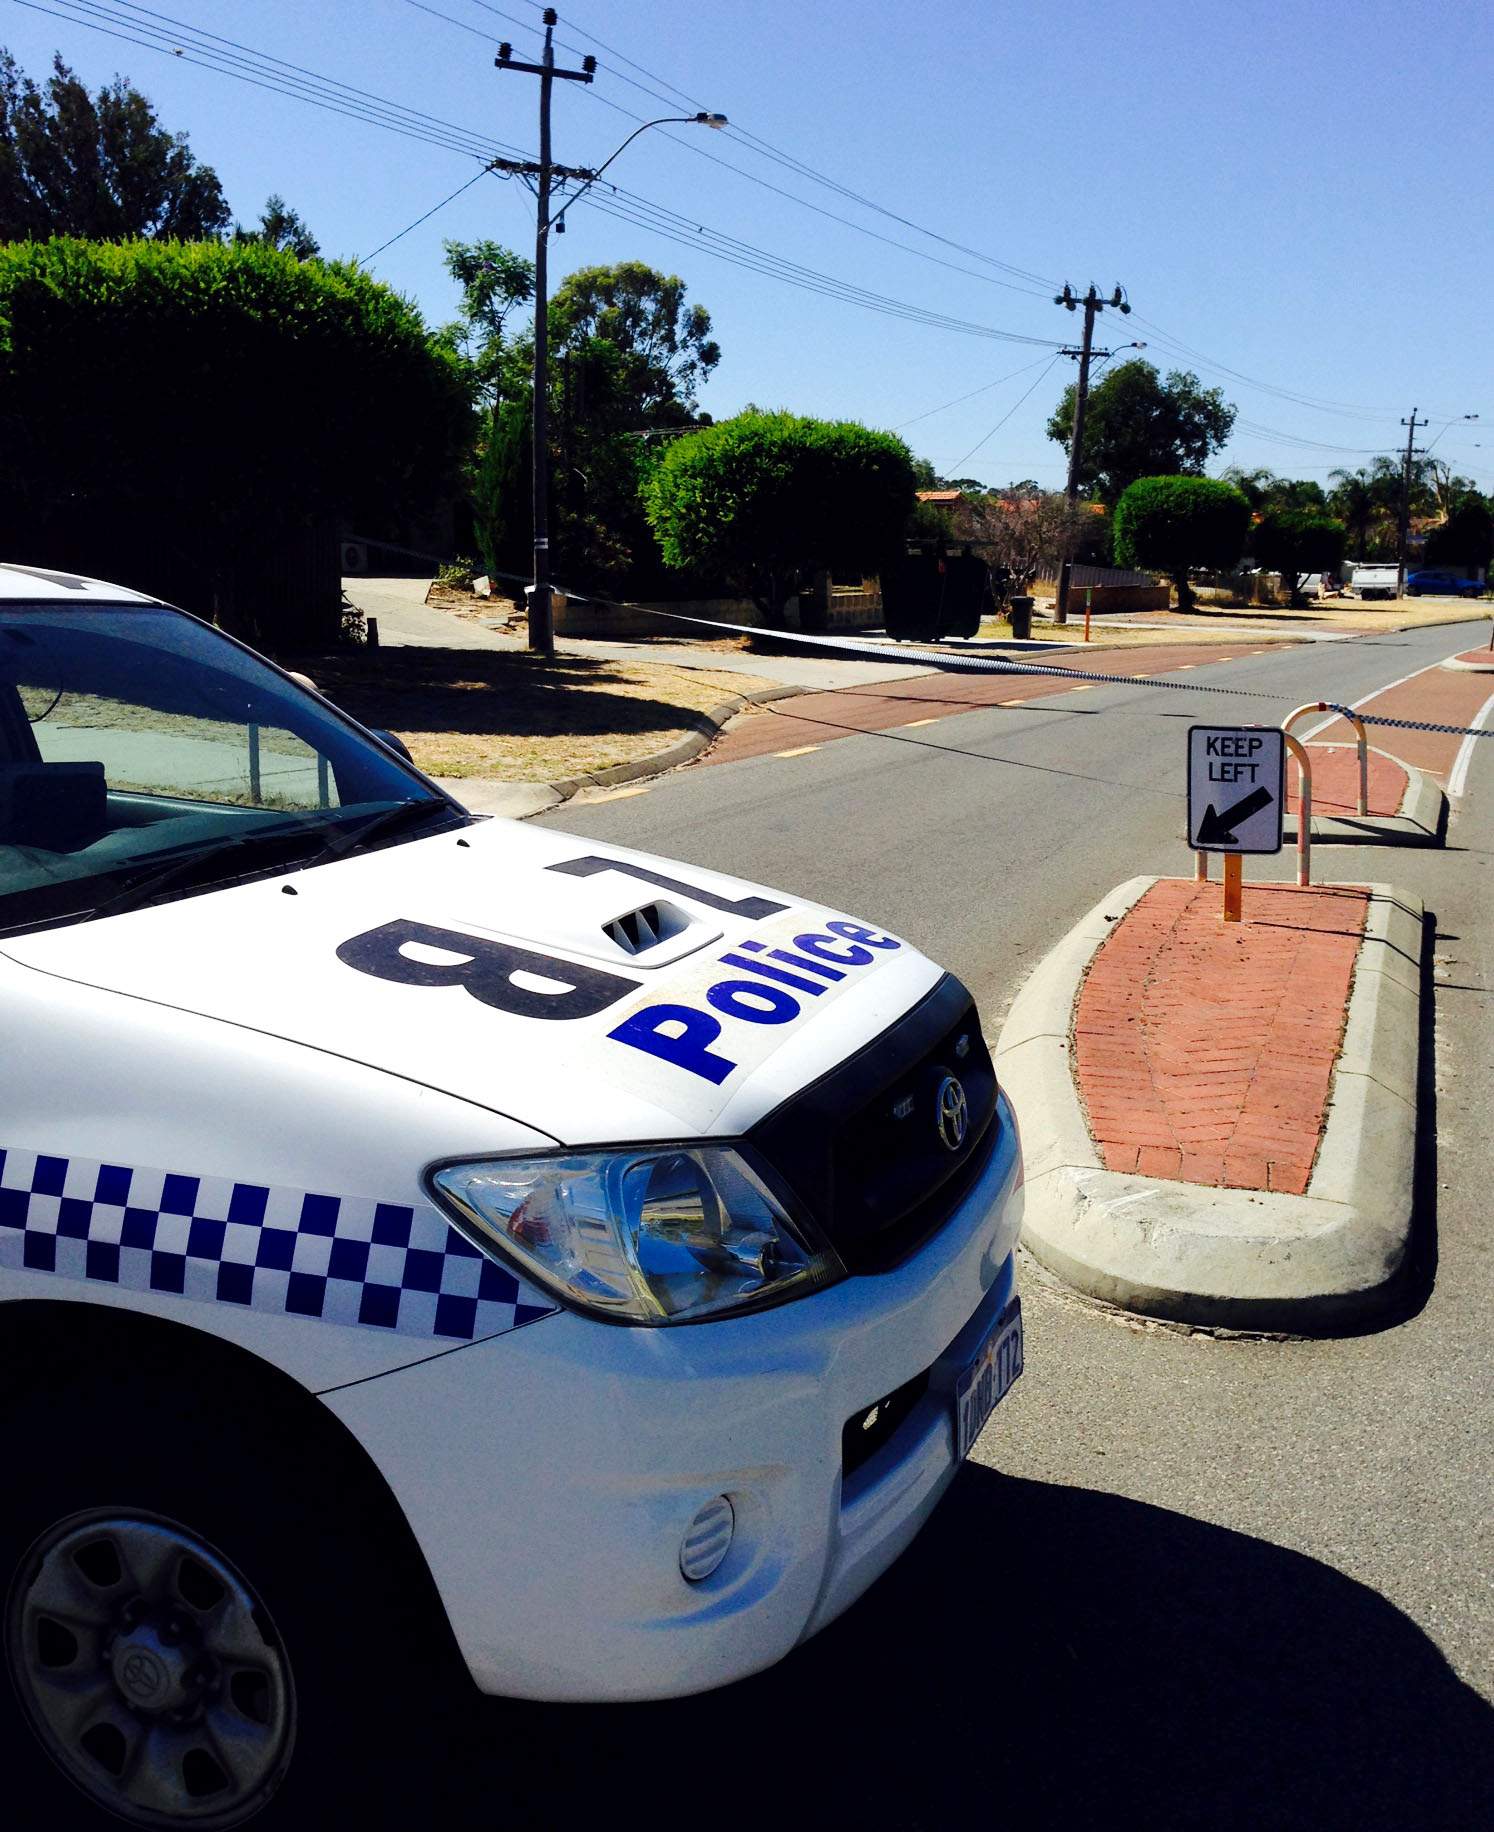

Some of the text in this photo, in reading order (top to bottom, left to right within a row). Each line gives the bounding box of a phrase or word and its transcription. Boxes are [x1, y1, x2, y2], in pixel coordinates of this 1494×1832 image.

[1206, 736, 1263, 757] KEEP
[1208, 761, 1260, 783] LEFT
[606, 920, 901, 1085] Police
